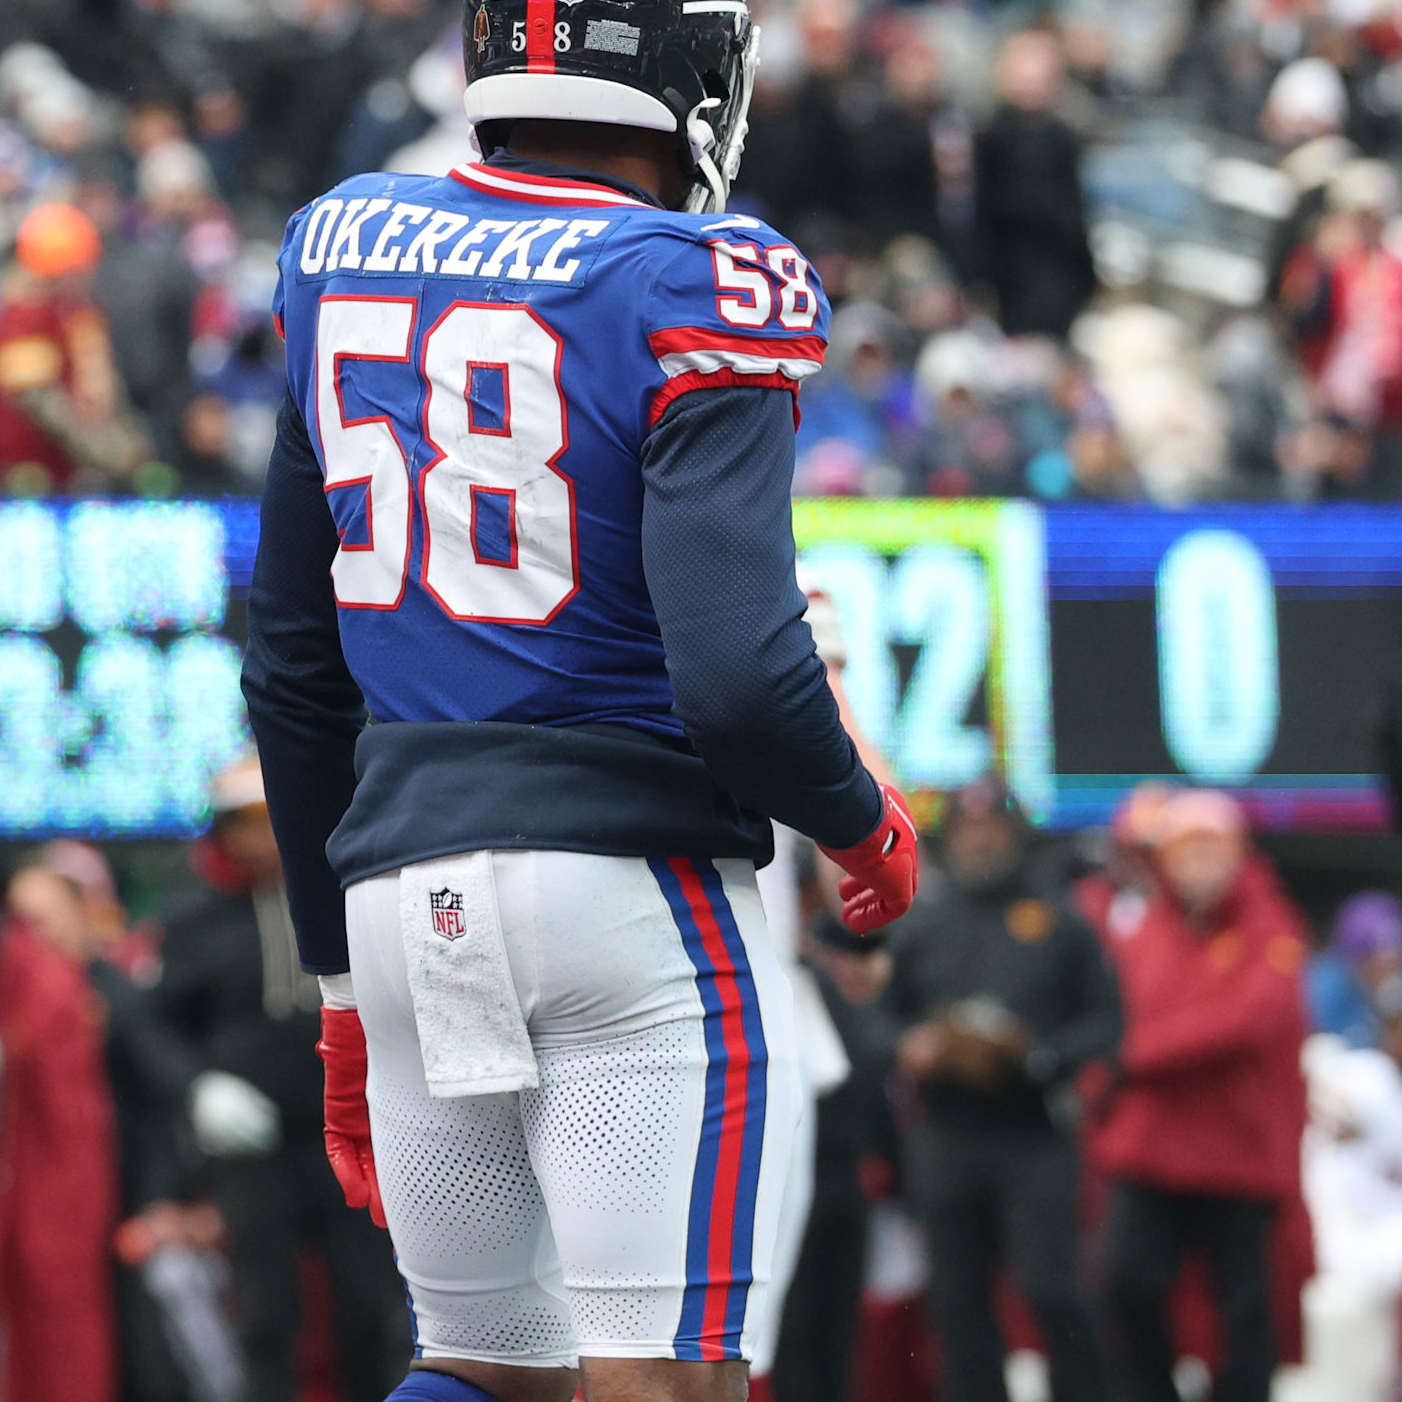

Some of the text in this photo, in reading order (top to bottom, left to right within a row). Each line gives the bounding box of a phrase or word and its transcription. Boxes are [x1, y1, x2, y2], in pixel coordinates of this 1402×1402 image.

[300, 198, 611, 282] OKEREKE
[705, 238, 818, 331] 58
[316, 295, 581, 626] 58
[1155, 527, 1281, 787] 0
[435, 911, 465, 936] NFL
